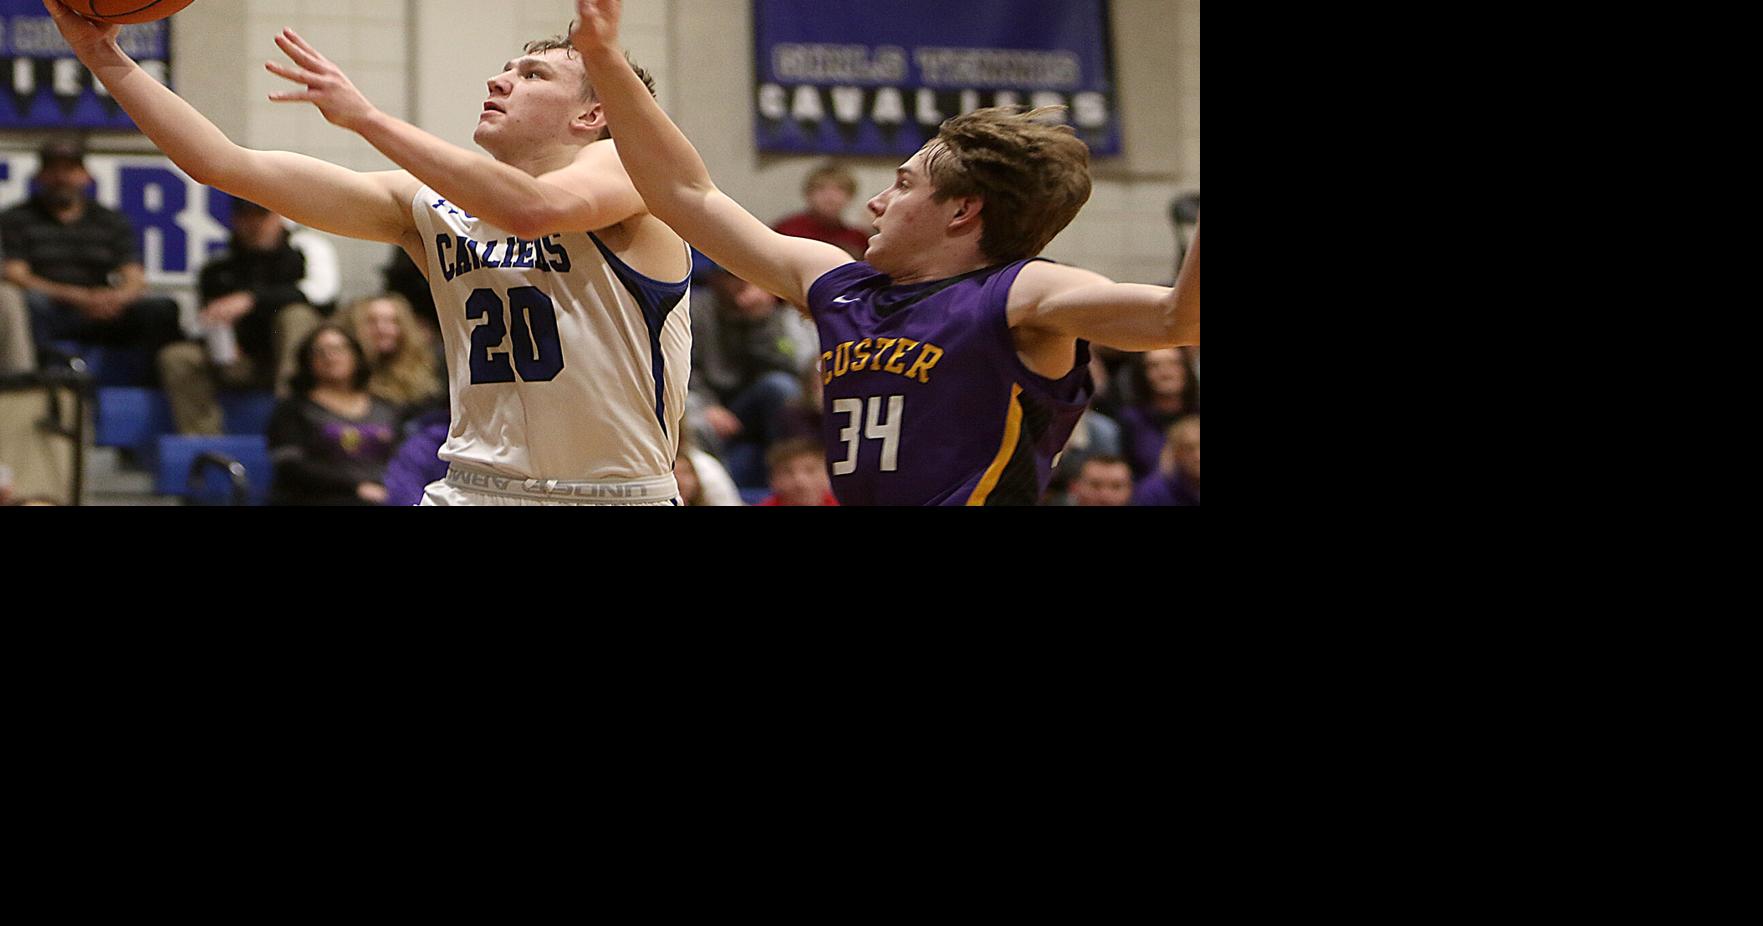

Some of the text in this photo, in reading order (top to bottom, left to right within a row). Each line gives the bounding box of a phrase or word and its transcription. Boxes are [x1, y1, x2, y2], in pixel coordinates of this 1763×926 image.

[465, 285, 565, 385] 20
[821, 337, 944, 384] CUSTER
[832, 395, 904, 476] 34
